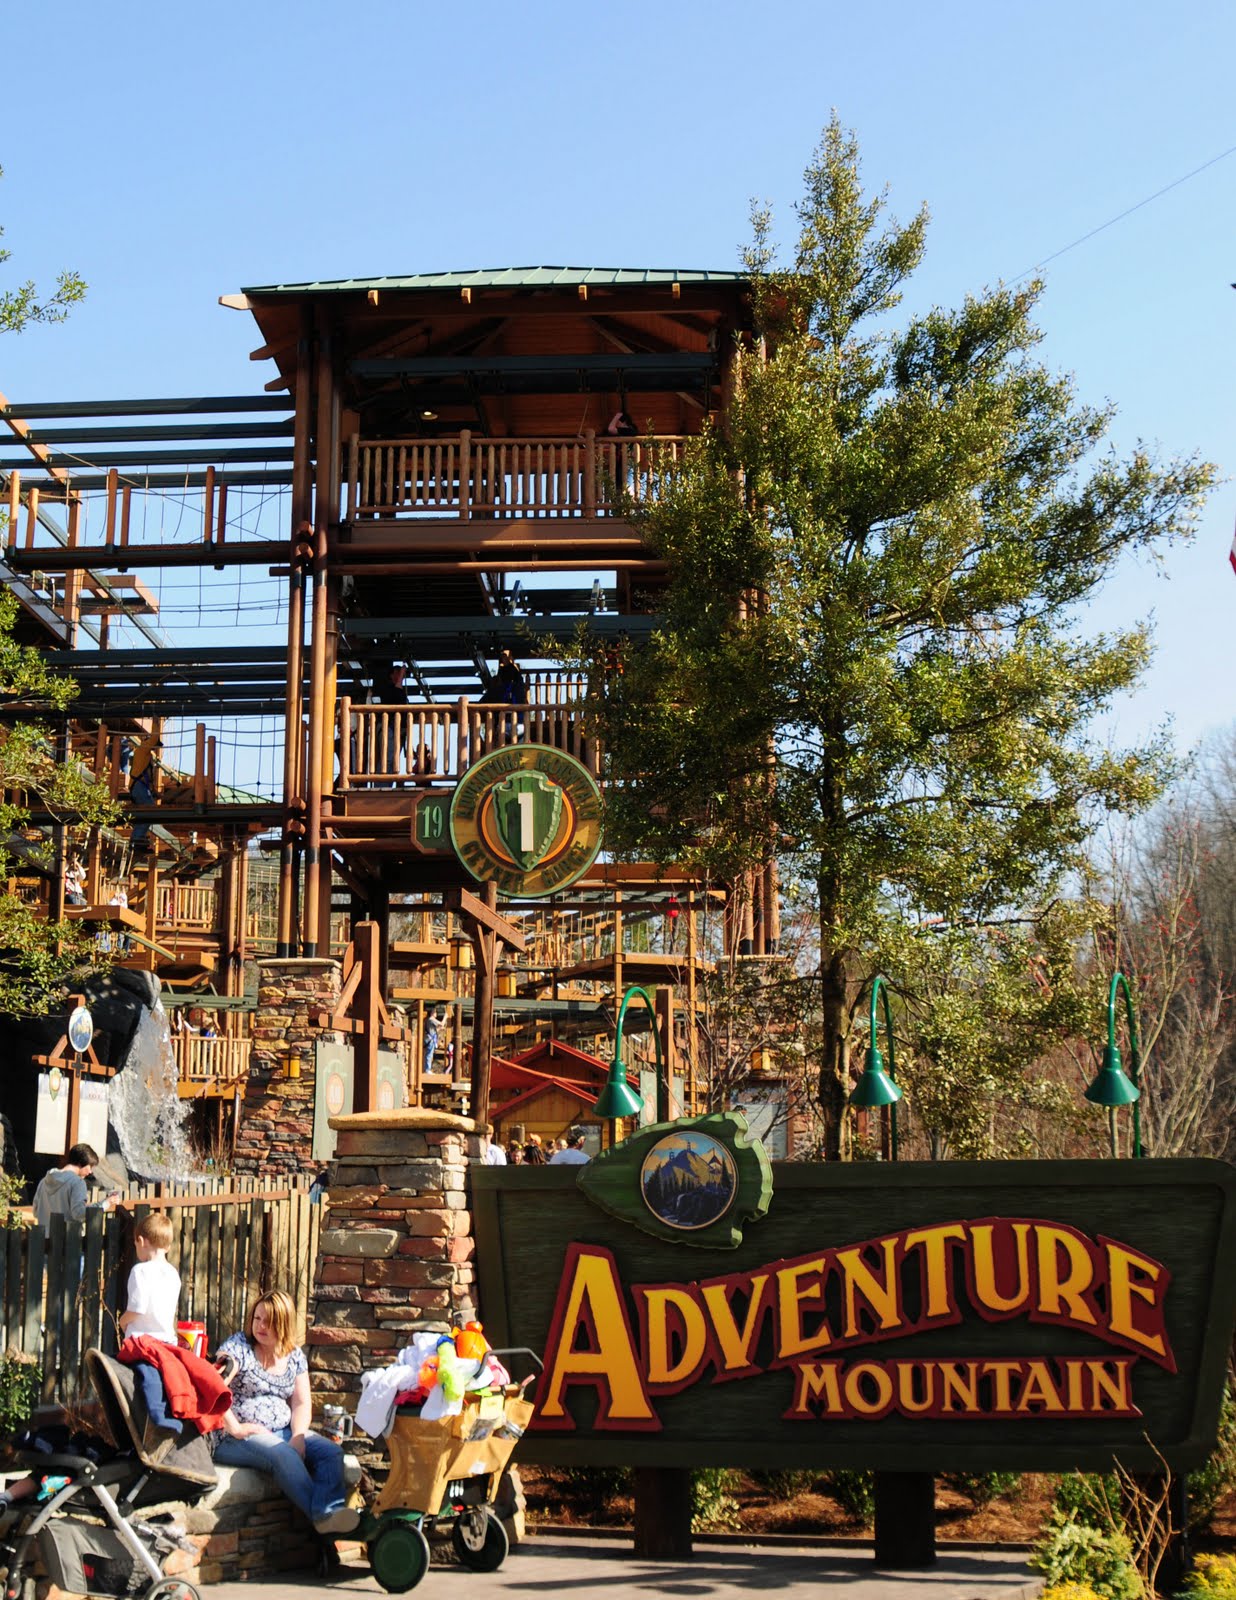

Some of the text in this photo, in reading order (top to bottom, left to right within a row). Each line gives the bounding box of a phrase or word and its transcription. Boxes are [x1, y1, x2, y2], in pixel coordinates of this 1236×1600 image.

[456, 751, 599, 820] ADVENTURE MOUNTAIN
[422, 805, 443, 838] 19
[518, 793, 533, 851] 1
[460, 841, 525, 892] GEYSER
[540, 1223, 1166, 1418] ADVENTURE
[796, 1361, 1131, 1412] MOUNTAIN
